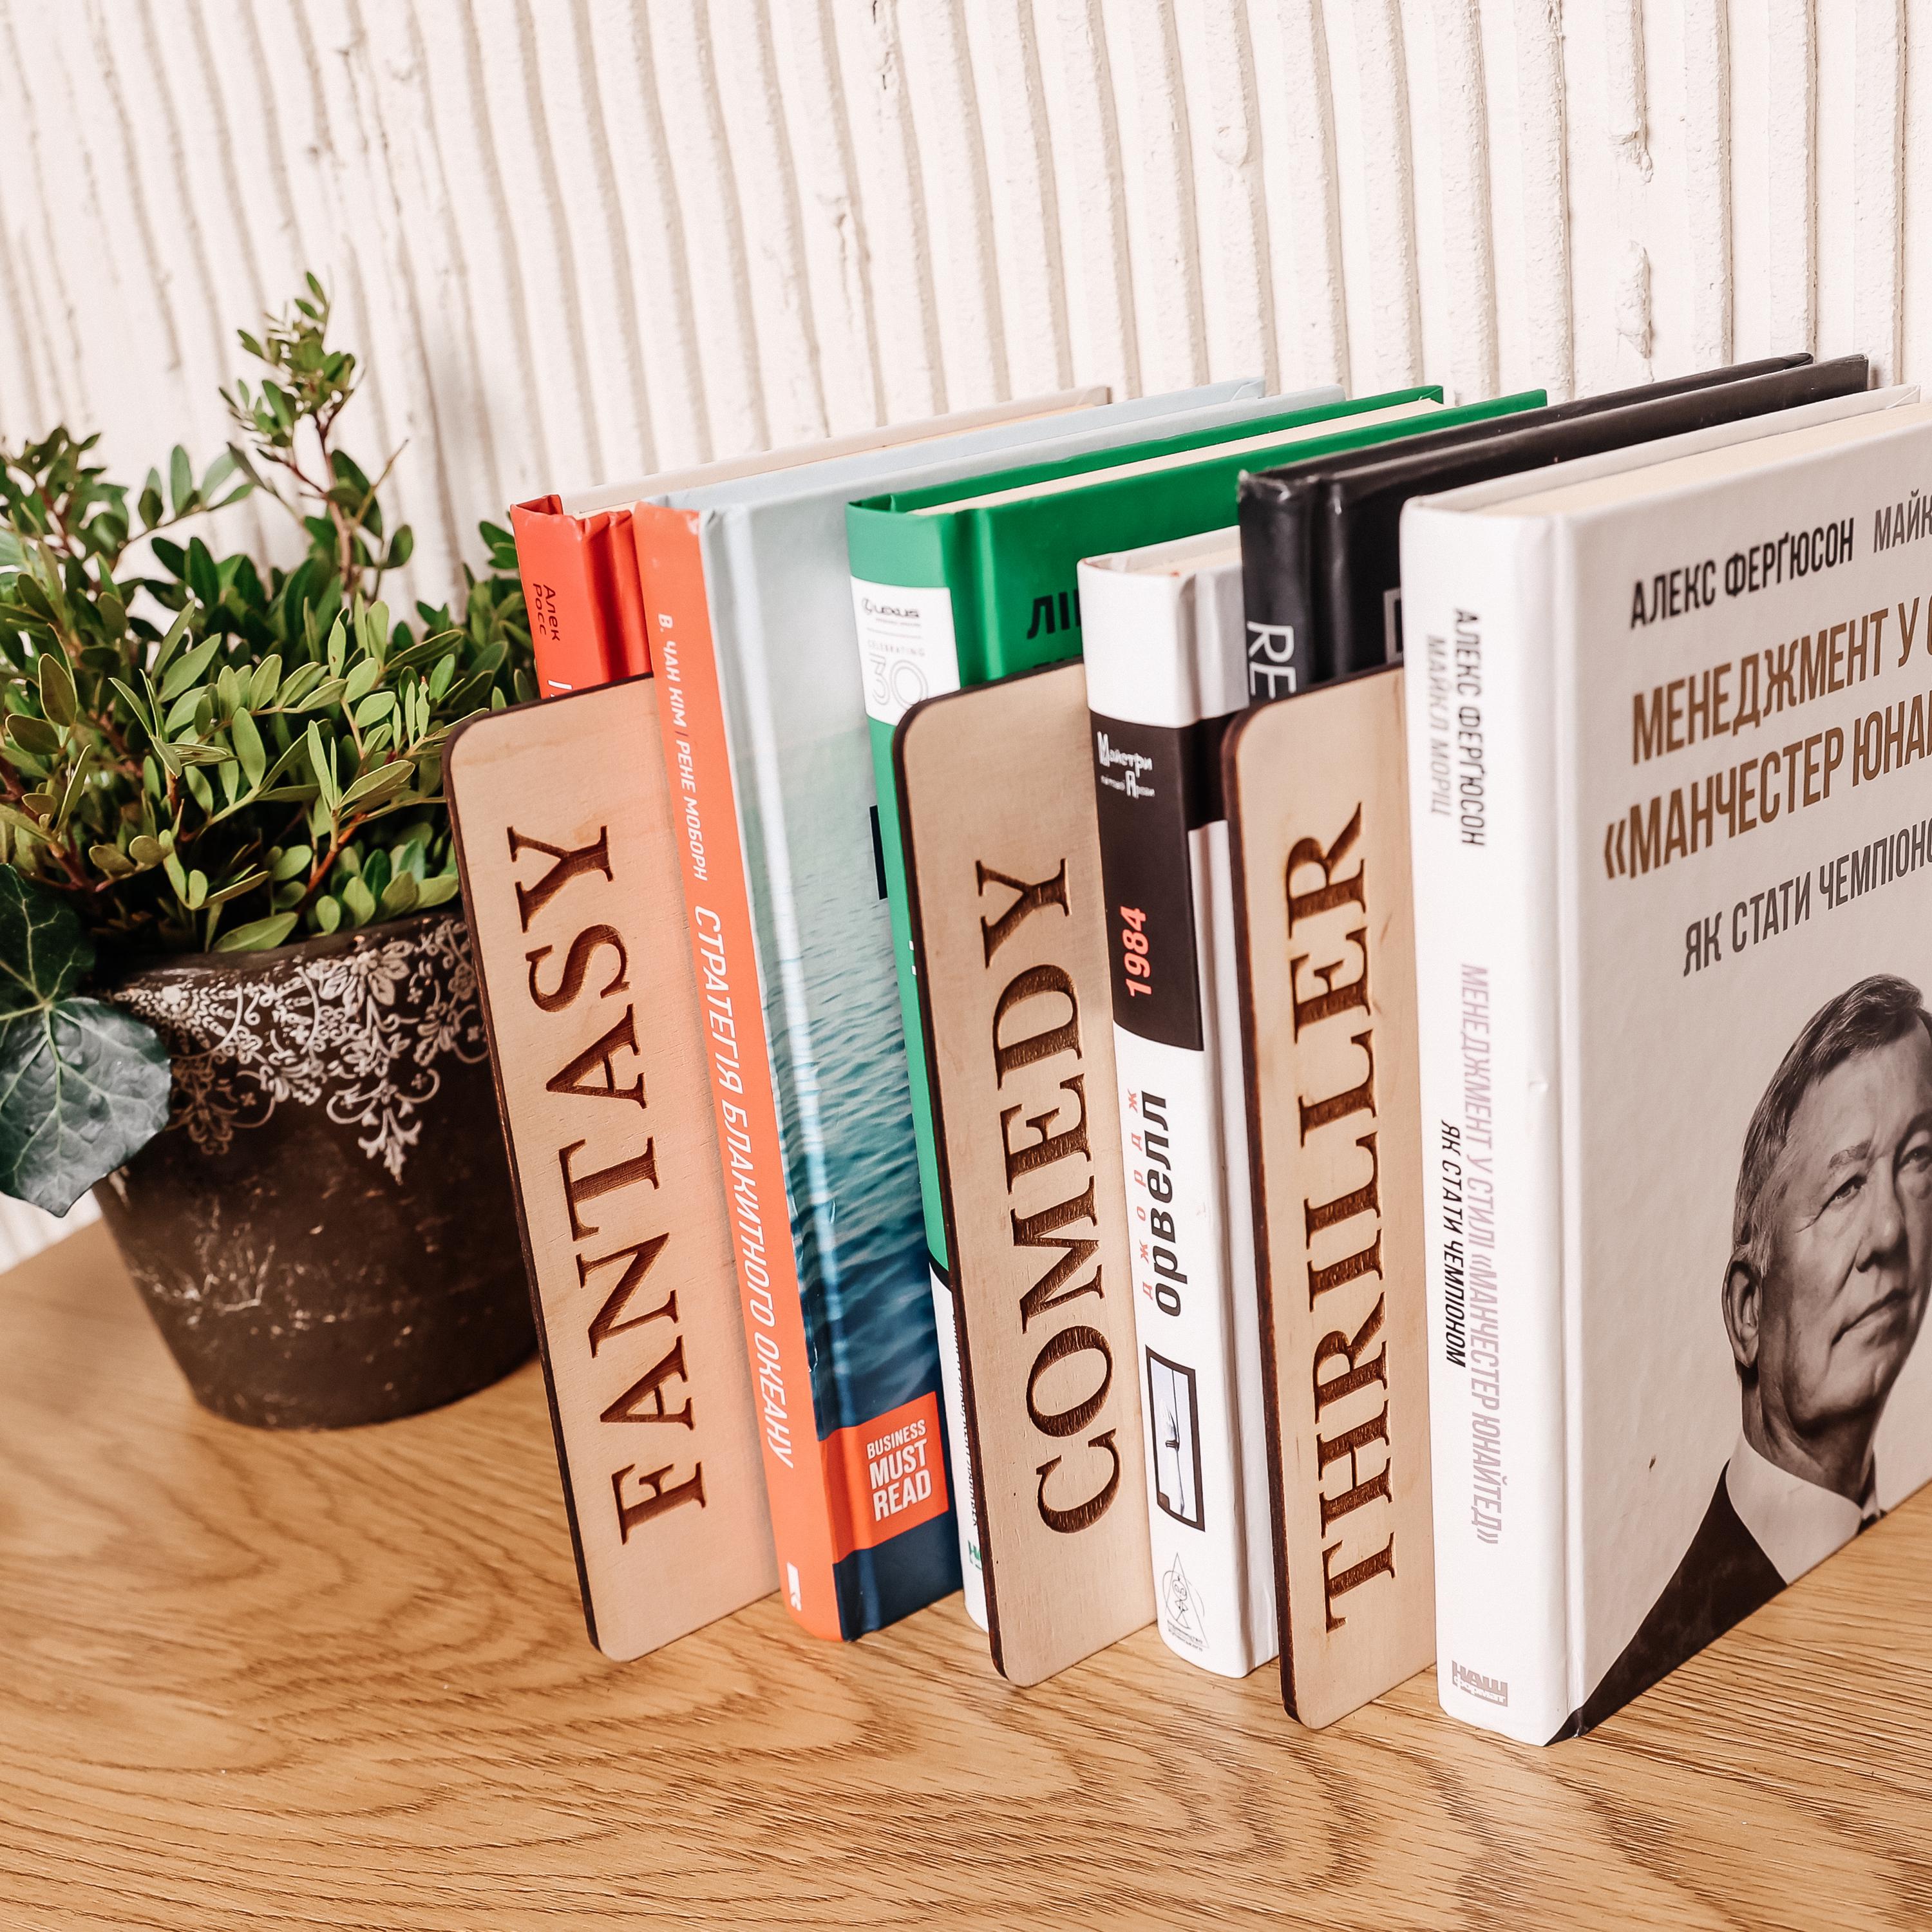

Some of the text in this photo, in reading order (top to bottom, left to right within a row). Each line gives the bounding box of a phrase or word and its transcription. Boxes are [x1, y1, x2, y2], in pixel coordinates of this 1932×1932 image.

[533, 583, 548, 636] Росс
[542, 584, 560, 641] Алек
[658, 613, 674, 632] В.
[1632, 560, 1716, 629] АЛЕКС
[1725, 516, 1854, 597] ФЕРҐЮСОН
[663, 640, 681, 682] ЧАН
[668, 687, 688, 728] КІМ
[1427, 634, 1449, 732] МАЙКЛ
[1633, 608, 1889, 766] МЕНЕДЖМЕНТ
[1898, 596, 1920, 668] У
[676, 739, 696, 793] РЕНЕ
[1455, 609, 1486, 846] АЛЕКС ФЕРҐЮСОН
[683, 796, 708, 881] МОБОРН
[1604, 726, 1844, 880] «МАНЧЕСТЕР
[1120, 905, 1152, 997] 1984
[1683, 911, 1723, 977] ЯК
[1732, 871, 1811, 953] СТАТИ
[506, 825, 707, 1546] FANTASY
[695, 905, 794, 1469] СТРАТЕГІЯ БЛАКИТНОГО ОКЕАНУ
[976, 858, 1121, 1535] COMEDY
[1141, 1090, 1188, 1317] орвелл
[1286, 801, 1397, 1635] THRILLER
[1441, 1119, 1466, 1368] ЯК СТАТИ ЧЕМПІОНОМ
[1461, 963, 1508, 1544] МЕНЕДЖМЕНТ У СТИЛІ «МАНЧЕСТЕР ЮНАЙТЕД»
[867, 1419, 926, 1460] BUSINESS
[869, 1439, 928, 1490] MUST
[873, 1469, 933, 1522] READ
